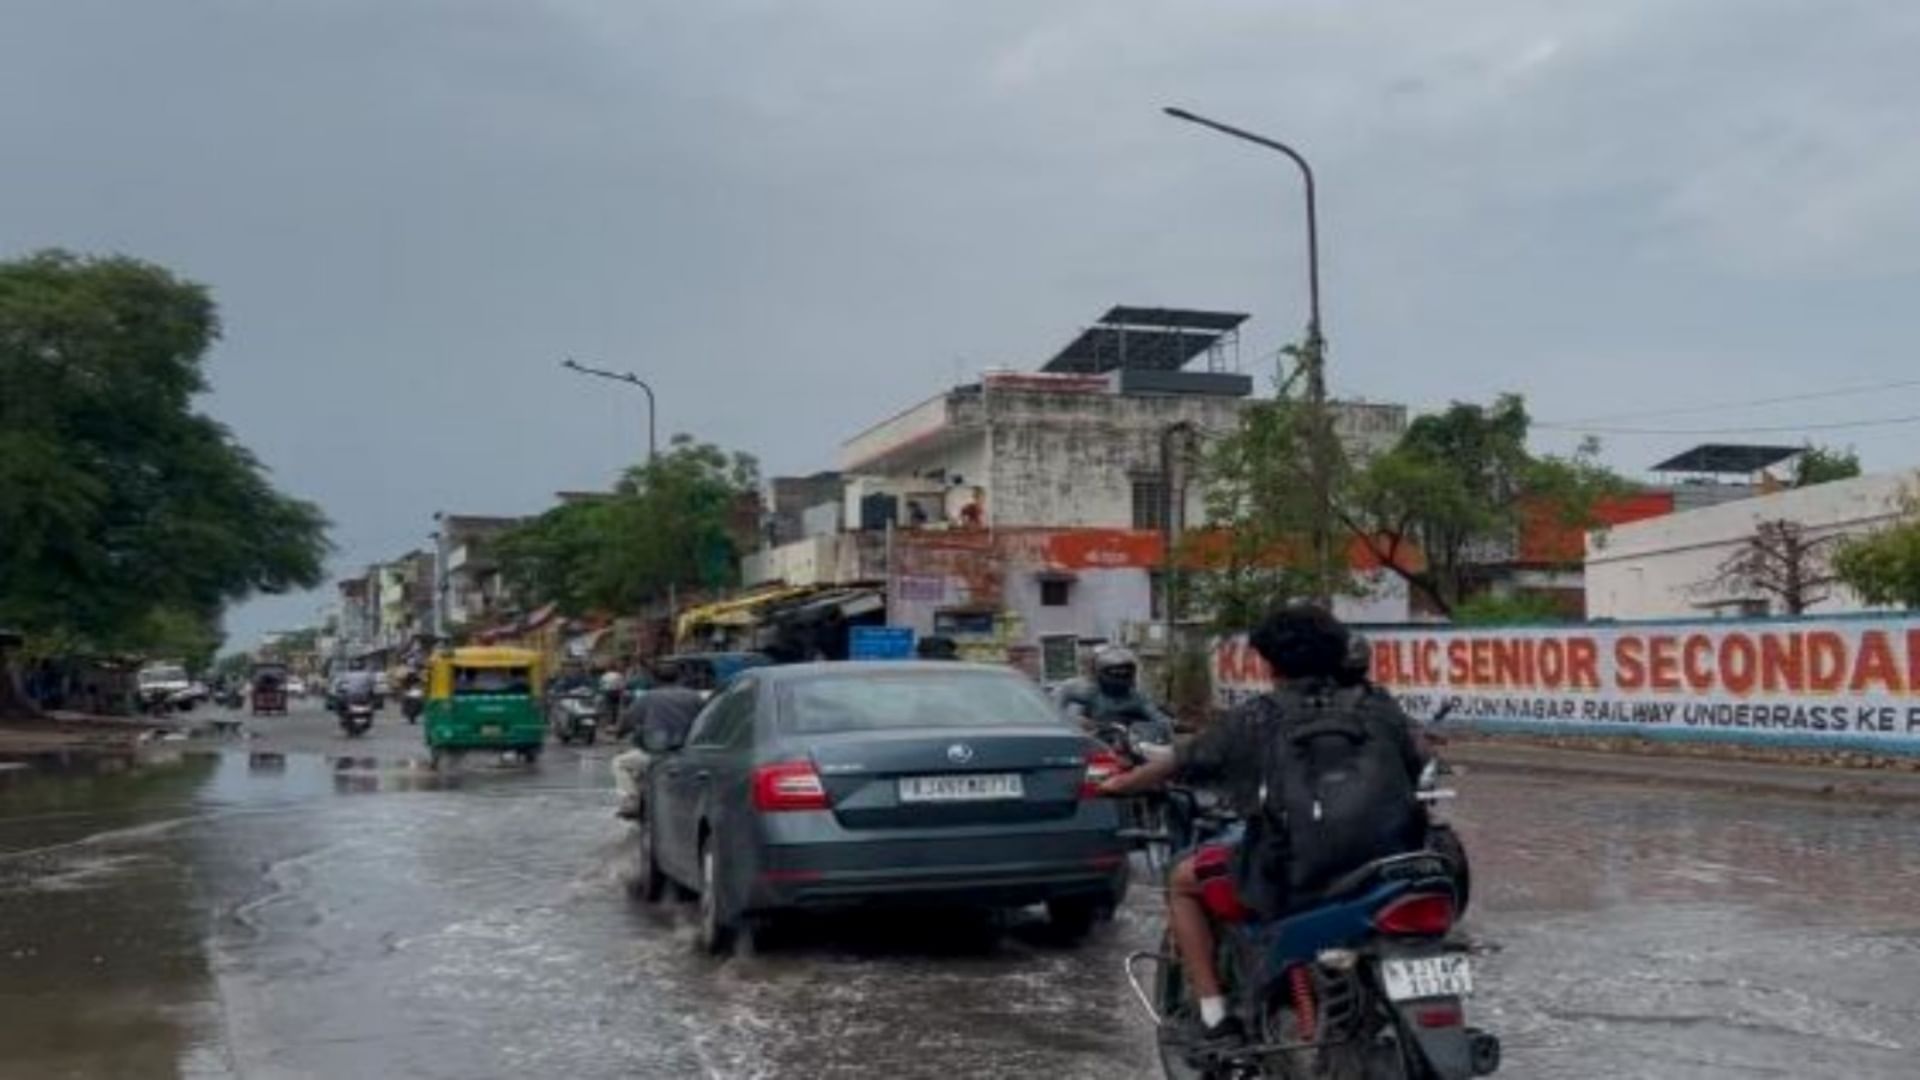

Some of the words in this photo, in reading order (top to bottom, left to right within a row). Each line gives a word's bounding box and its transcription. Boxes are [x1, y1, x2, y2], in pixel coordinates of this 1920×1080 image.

[1448, 637, 1601, 688] SENIOR
[1582, 700, 1674, 723] RAILWAY
[1856, 706, 1894, 731] KE
